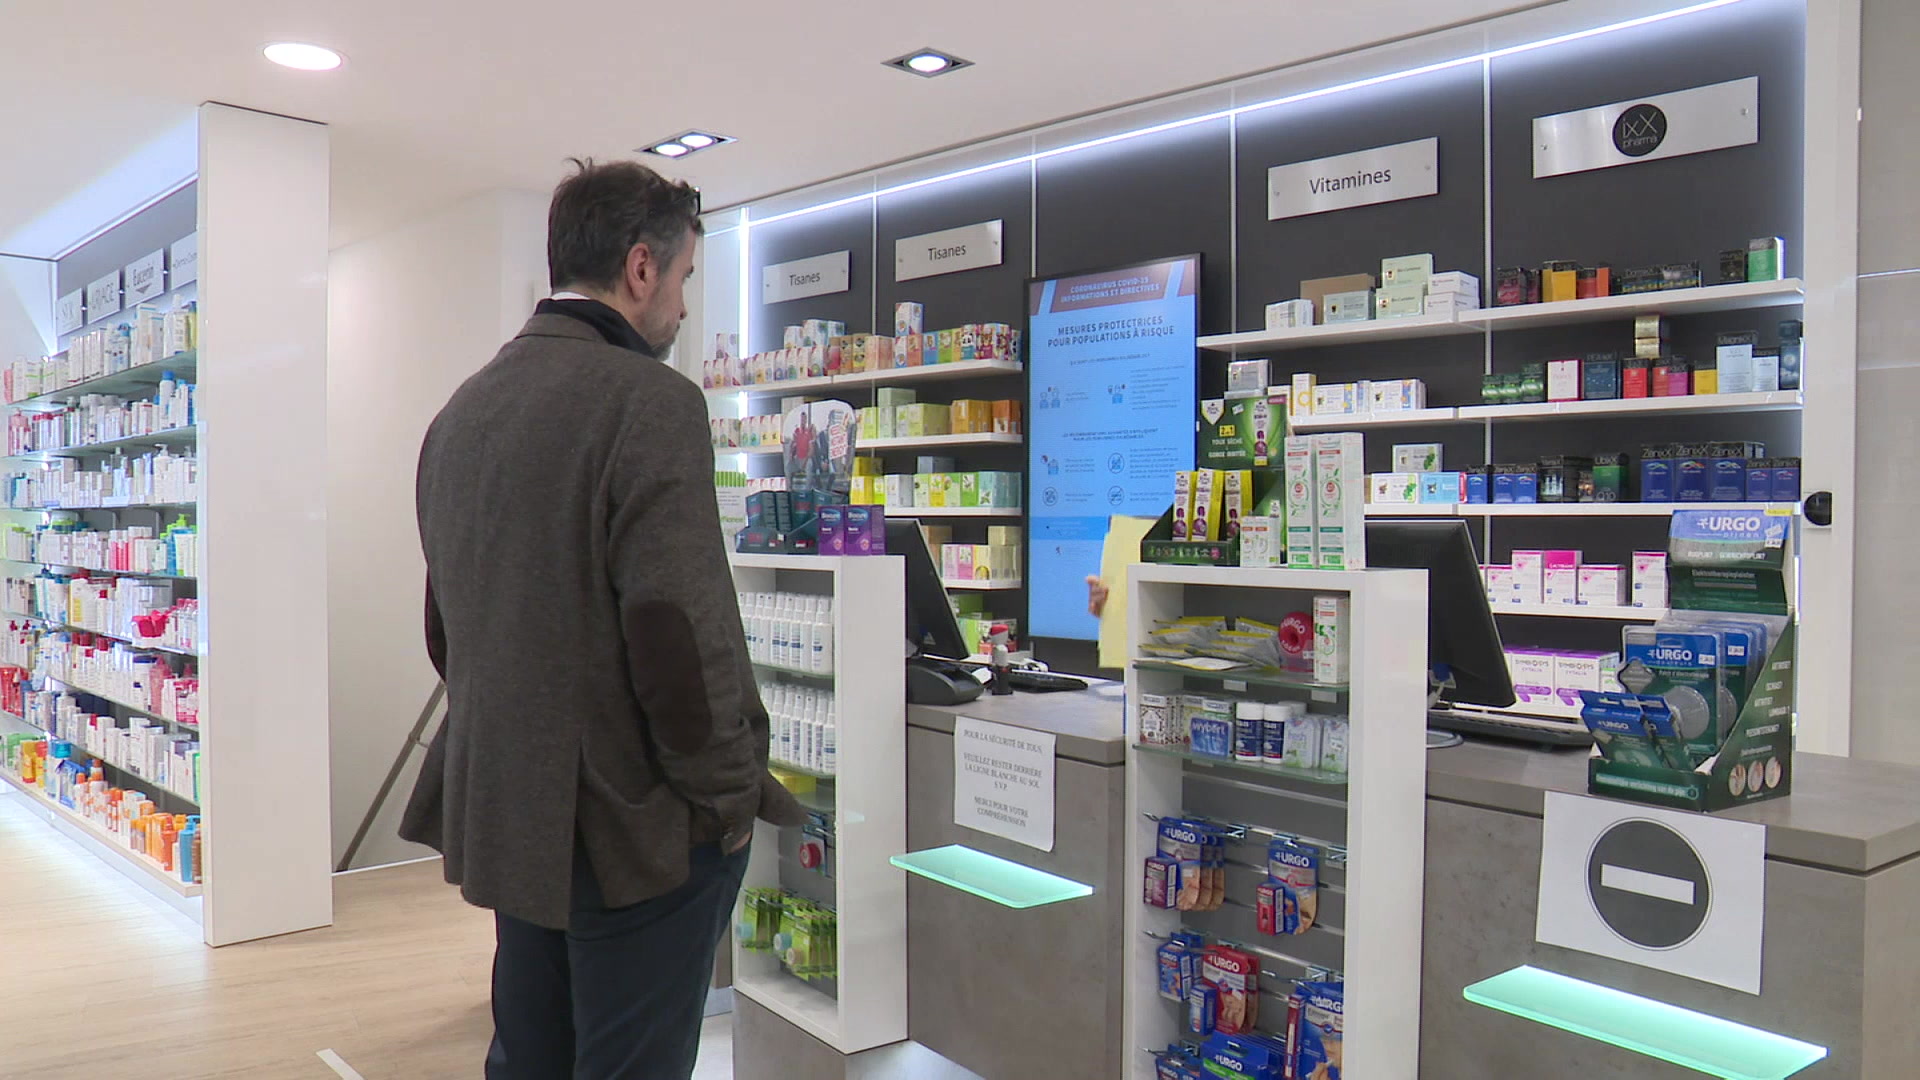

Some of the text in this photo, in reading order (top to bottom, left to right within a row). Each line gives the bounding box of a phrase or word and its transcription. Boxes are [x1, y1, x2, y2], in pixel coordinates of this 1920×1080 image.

[1623, 132, 1658, 149] pharma
[1310, 166, 1392, 195] Vitamines
[928, 244, 966, 261] Tisanes
[789, 271, 820, 286] Tisanes
[1070, 276, 1149, 293] CORONAVIRUS COVID-19
[1061, 283, 1160, 302] INFORMATIONS ET DIRECTIVES
[1058, 315, 1163, 336] MESURES PROTECTRICES
[1048, 325, 1174, 347] POUR POPULATIONS À RISQUE
[1709, 516, 1761, 531] URGO
[1283, 617, 1305, 634] URGO
[1655, 648, 1692, 661] URGO
[964, 729, 980, 738] POUR
[980, 732, 988, 741] LA
[988, 733, 1016, 748] SÉCURITÉ
[1016, 740, 1026, 750] DE
[963, 752, 991, 765] VEUILLEZ
[991, 757, 1013, 771] RESTER
[965, 763, 1040, 789] LA LIGNE BLANCHE AU SOL
[974, 795, 1029, 818] MERCI POUR VOTRE
[976, 807, 1027, 828] COMPRÉHENSION
[1170, 828, 1196, 843] URGO
[1281, 852, 1309, 867] URGO
[1214, 956, 1240, 972] URGO
[1316, 998, 1343, 1012] URG
[1220, 1056, 1243, 1071] URGO
